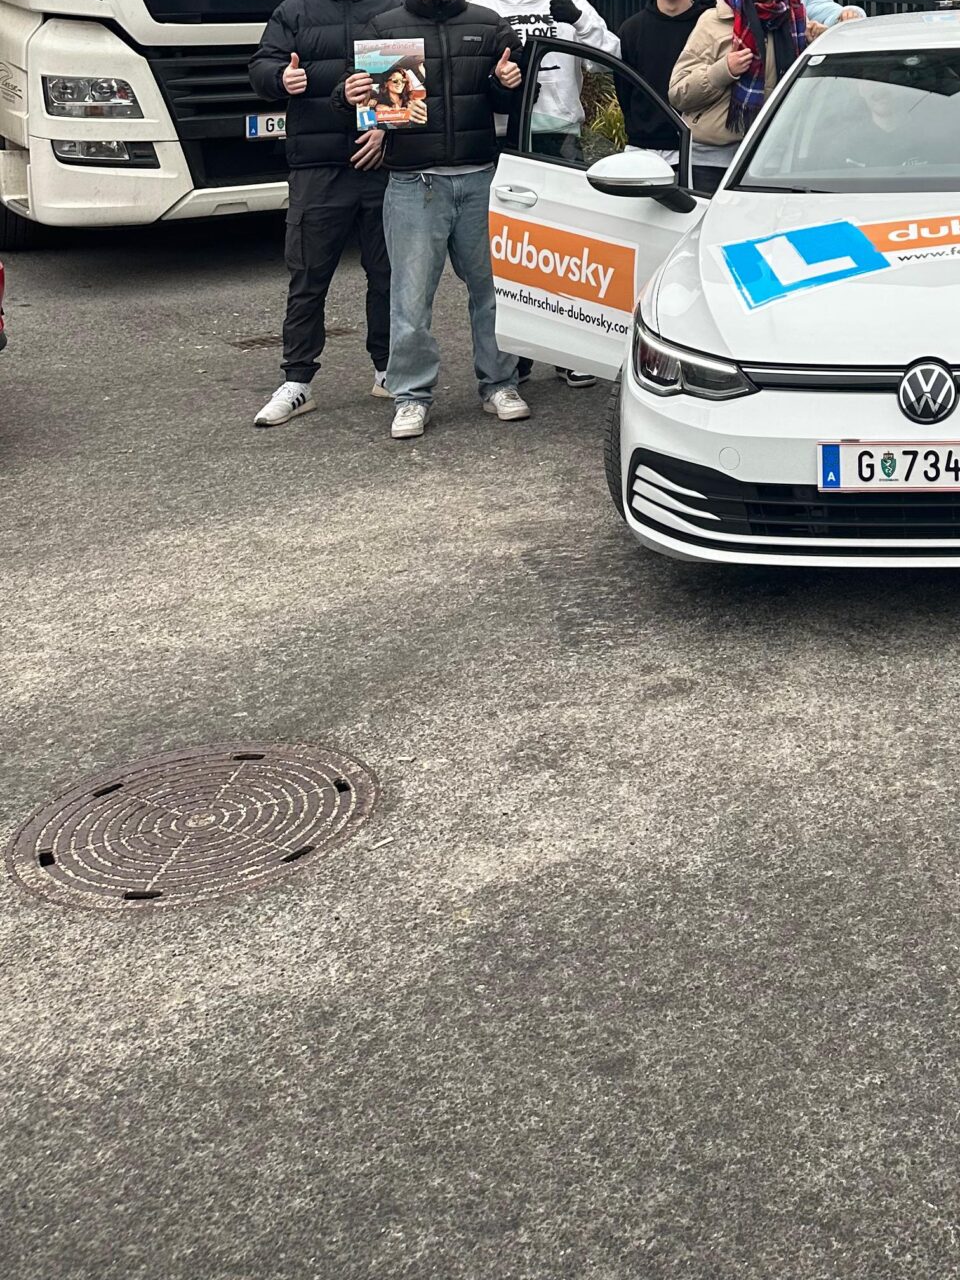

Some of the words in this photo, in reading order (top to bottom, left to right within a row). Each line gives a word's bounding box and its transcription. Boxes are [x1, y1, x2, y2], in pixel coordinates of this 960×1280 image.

[265, 117, 275, 133] G
[491, 225, 615, 299] dubovsky
[754, 236, 858, 287] L
[826, 471, 836, 482] A
[857, 450, 875, 482] G
